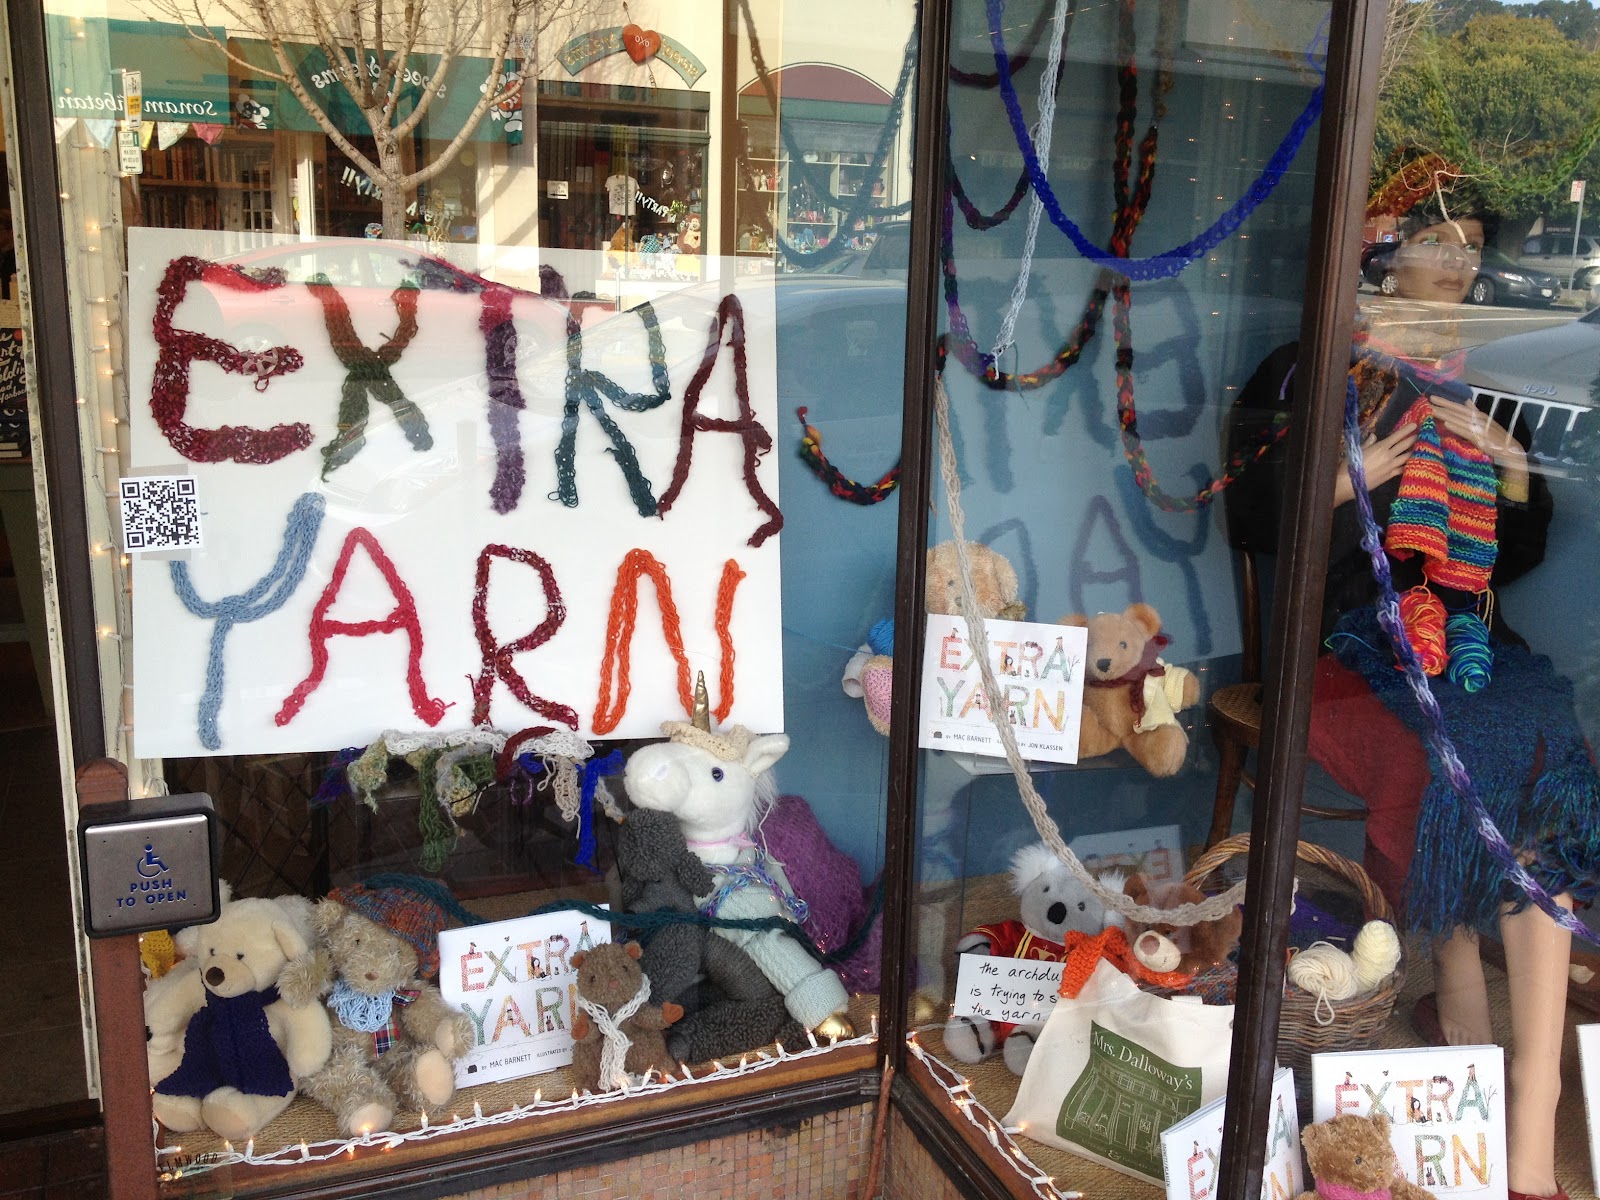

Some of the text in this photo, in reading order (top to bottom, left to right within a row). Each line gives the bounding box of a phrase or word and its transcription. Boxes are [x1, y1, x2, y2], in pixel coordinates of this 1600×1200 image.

[149, 255, 784, 548] EXTRA
[170, 492, 748, 751] YARN
[966, 735, 991, 744] BARNETT
[1039, 743, 1064, 751] KLASSEN
[130, 878, 173, 893] PUSH
[116, 890, 187, 908] TO OPEN
[979, 962, 1060, 982] the archdu
[970, 984, 982, 997] is
[991, 983, 1026, 1006] trying
[1032, 989, 1045, 1002] to
[971, 1003, 992, 1016] the
[489, 1059, 503, 1069] MAC
[504, 1054, 531, 1066] BARNETT
[1093, 1030, 1193, 1092] Mrs. Dalloway's
